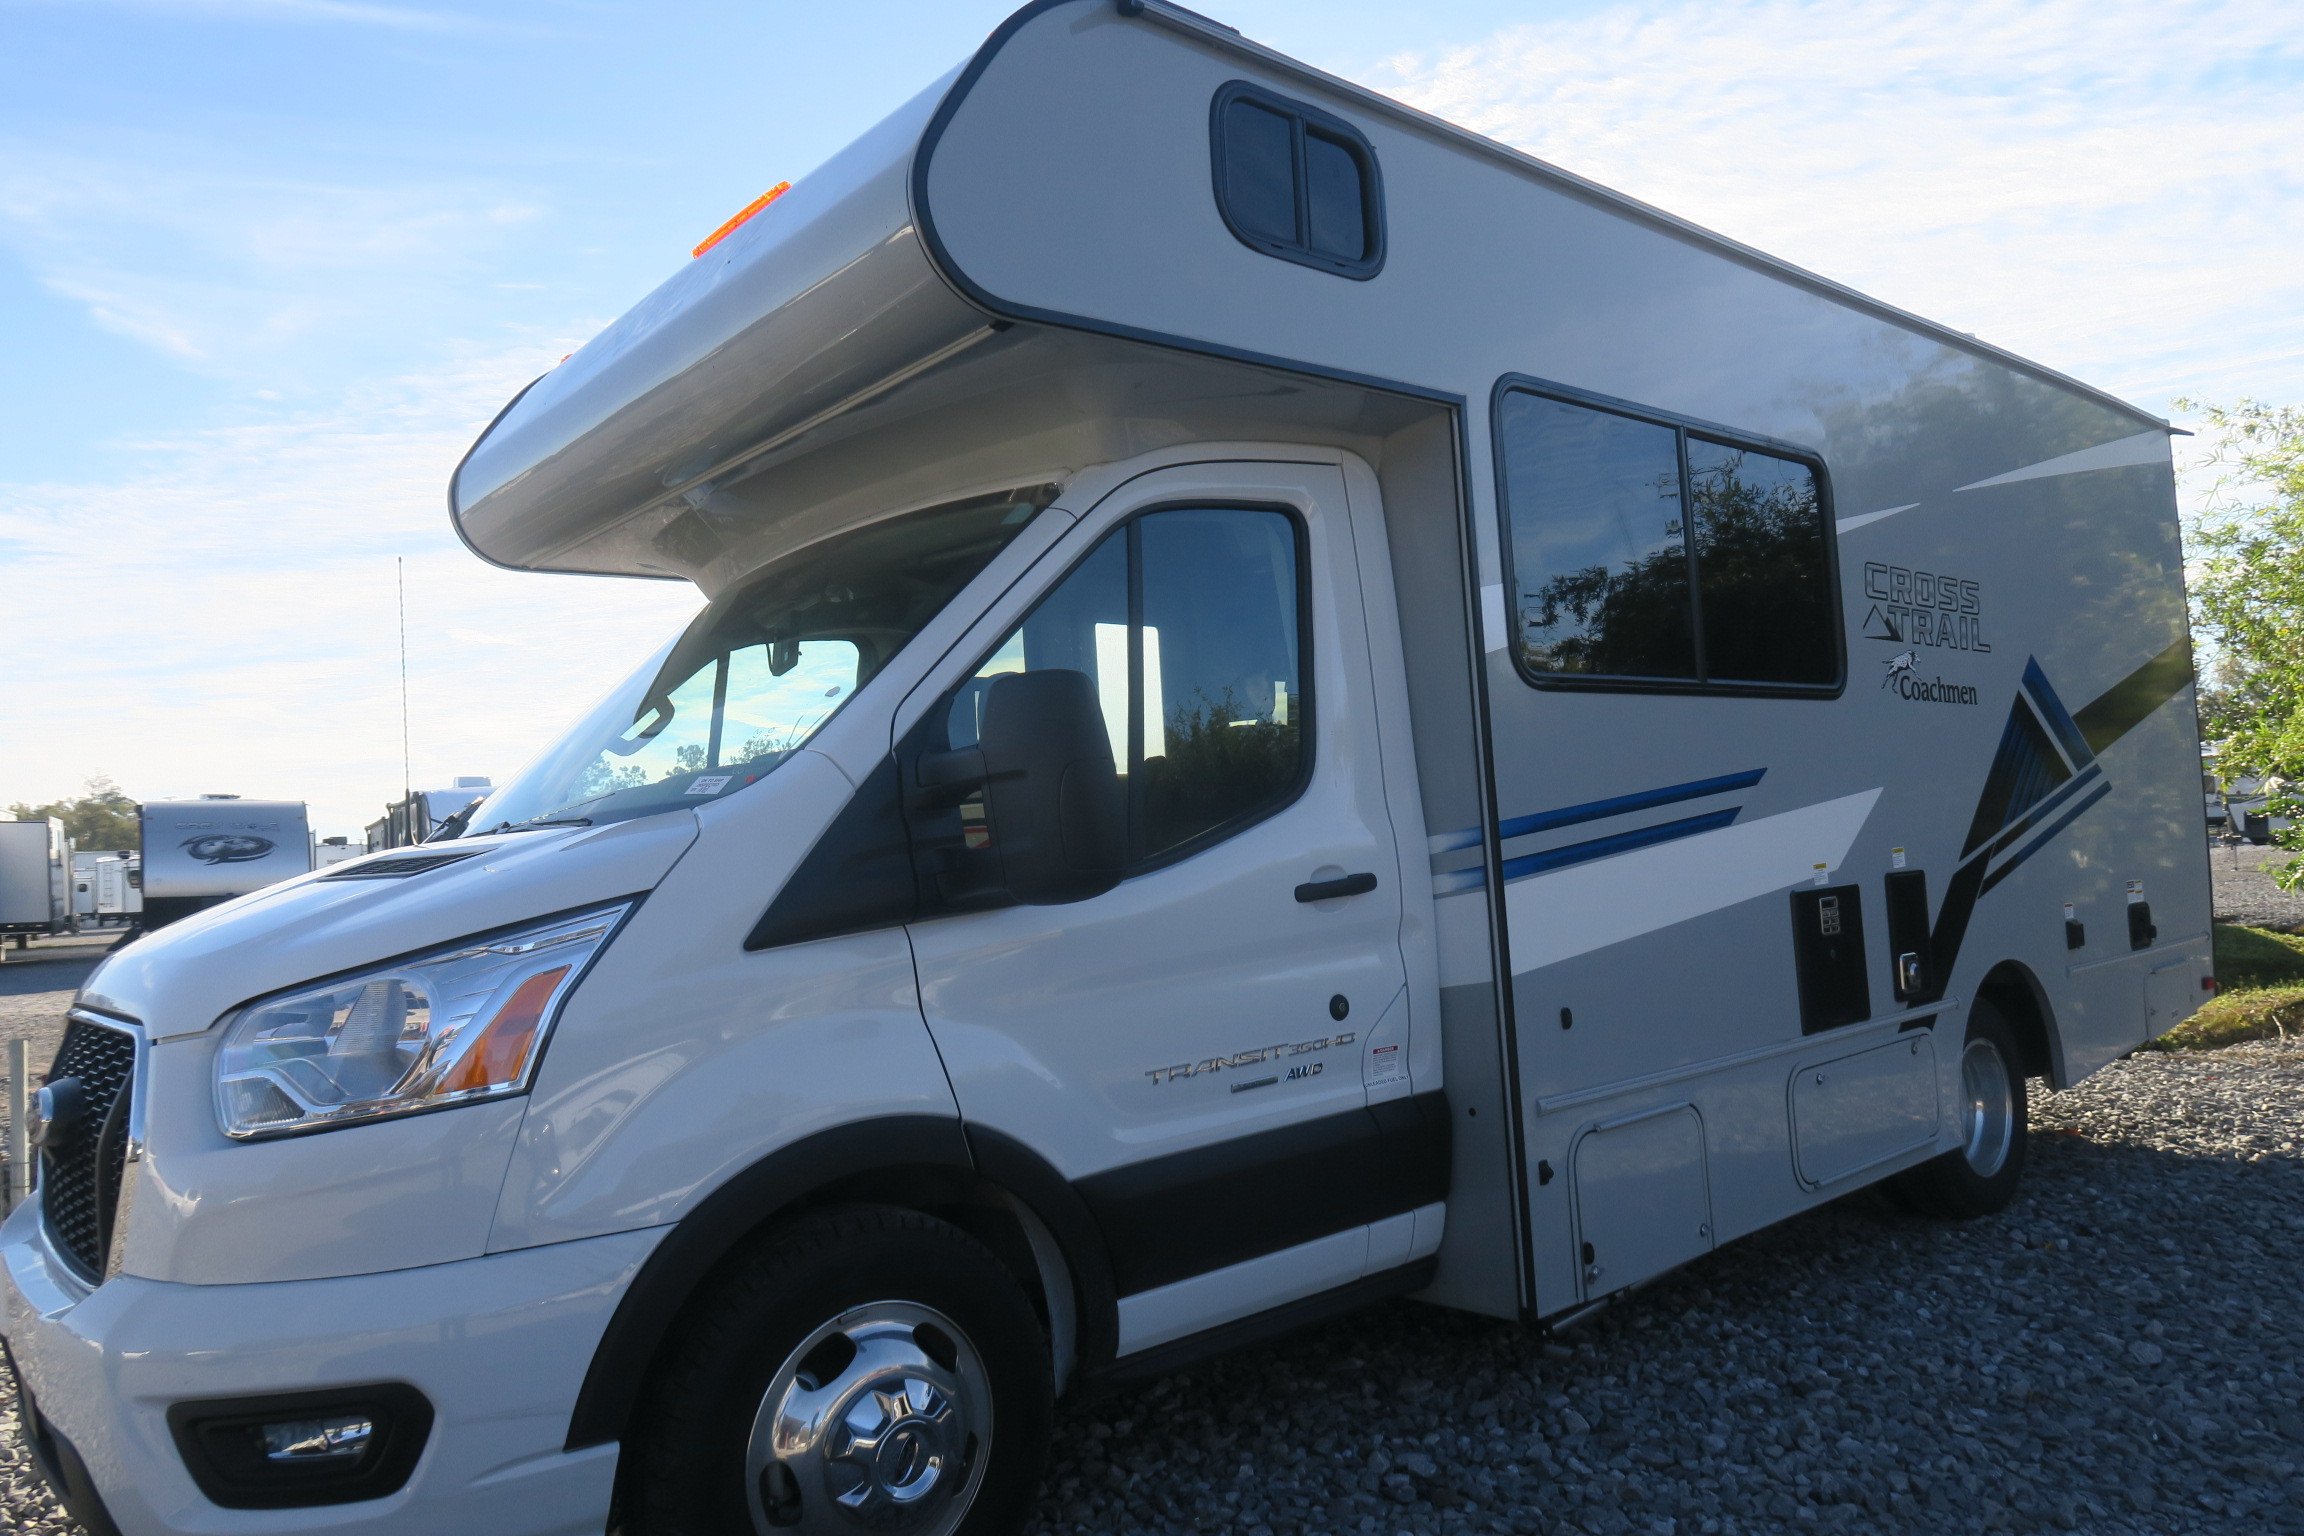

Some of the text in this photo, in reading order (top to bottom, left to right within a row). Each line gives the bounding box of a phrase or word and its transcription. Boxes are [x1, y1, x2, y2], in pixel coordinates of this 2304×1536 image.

[1864, 561, 1980, 616] CROSS
[1887, 604, 1991, 653] TRAIL
[1899, 675, 1978, 706] Coachmen
[1144, 1043, 1289, 1085] TRANSIT
[1283, 1062, 1323, 1082] AWD
